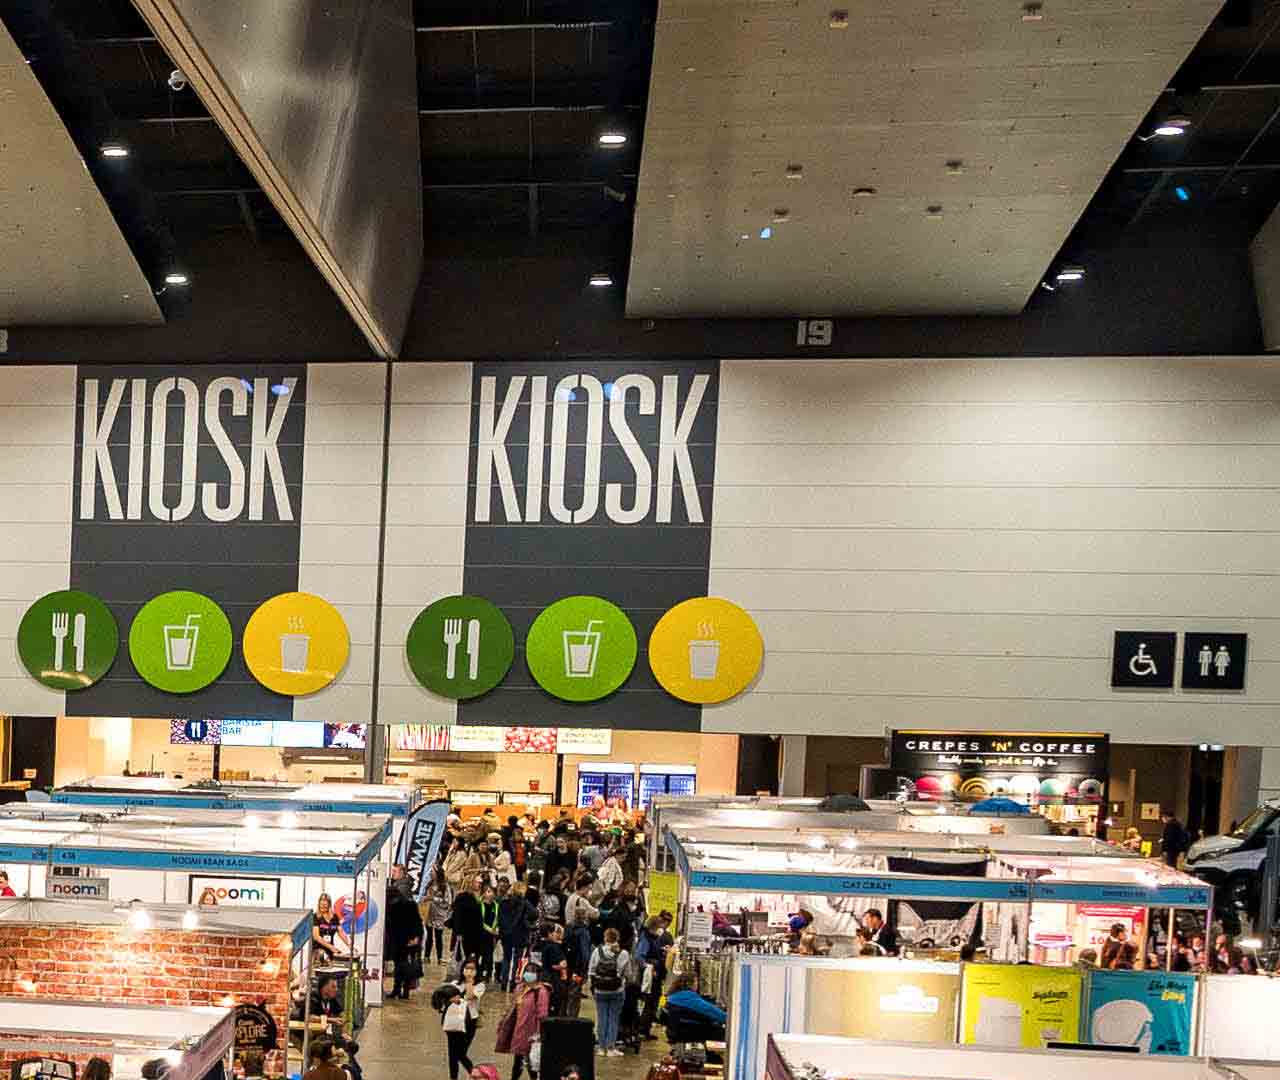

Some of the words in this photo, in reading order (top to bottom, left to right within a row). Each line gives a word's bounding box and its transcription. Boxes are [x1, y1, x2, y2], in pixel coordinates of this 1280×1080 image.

[797, 320, 833, 347] 19
[78, 376, 299, 521] KIOSK
[475, 374, 709, 524] KIOSK
[905, 740, 980, 751] CREPES
[1019, 743, 1096, 753] COFFEE
[52, 882, 101, 897] noomi
